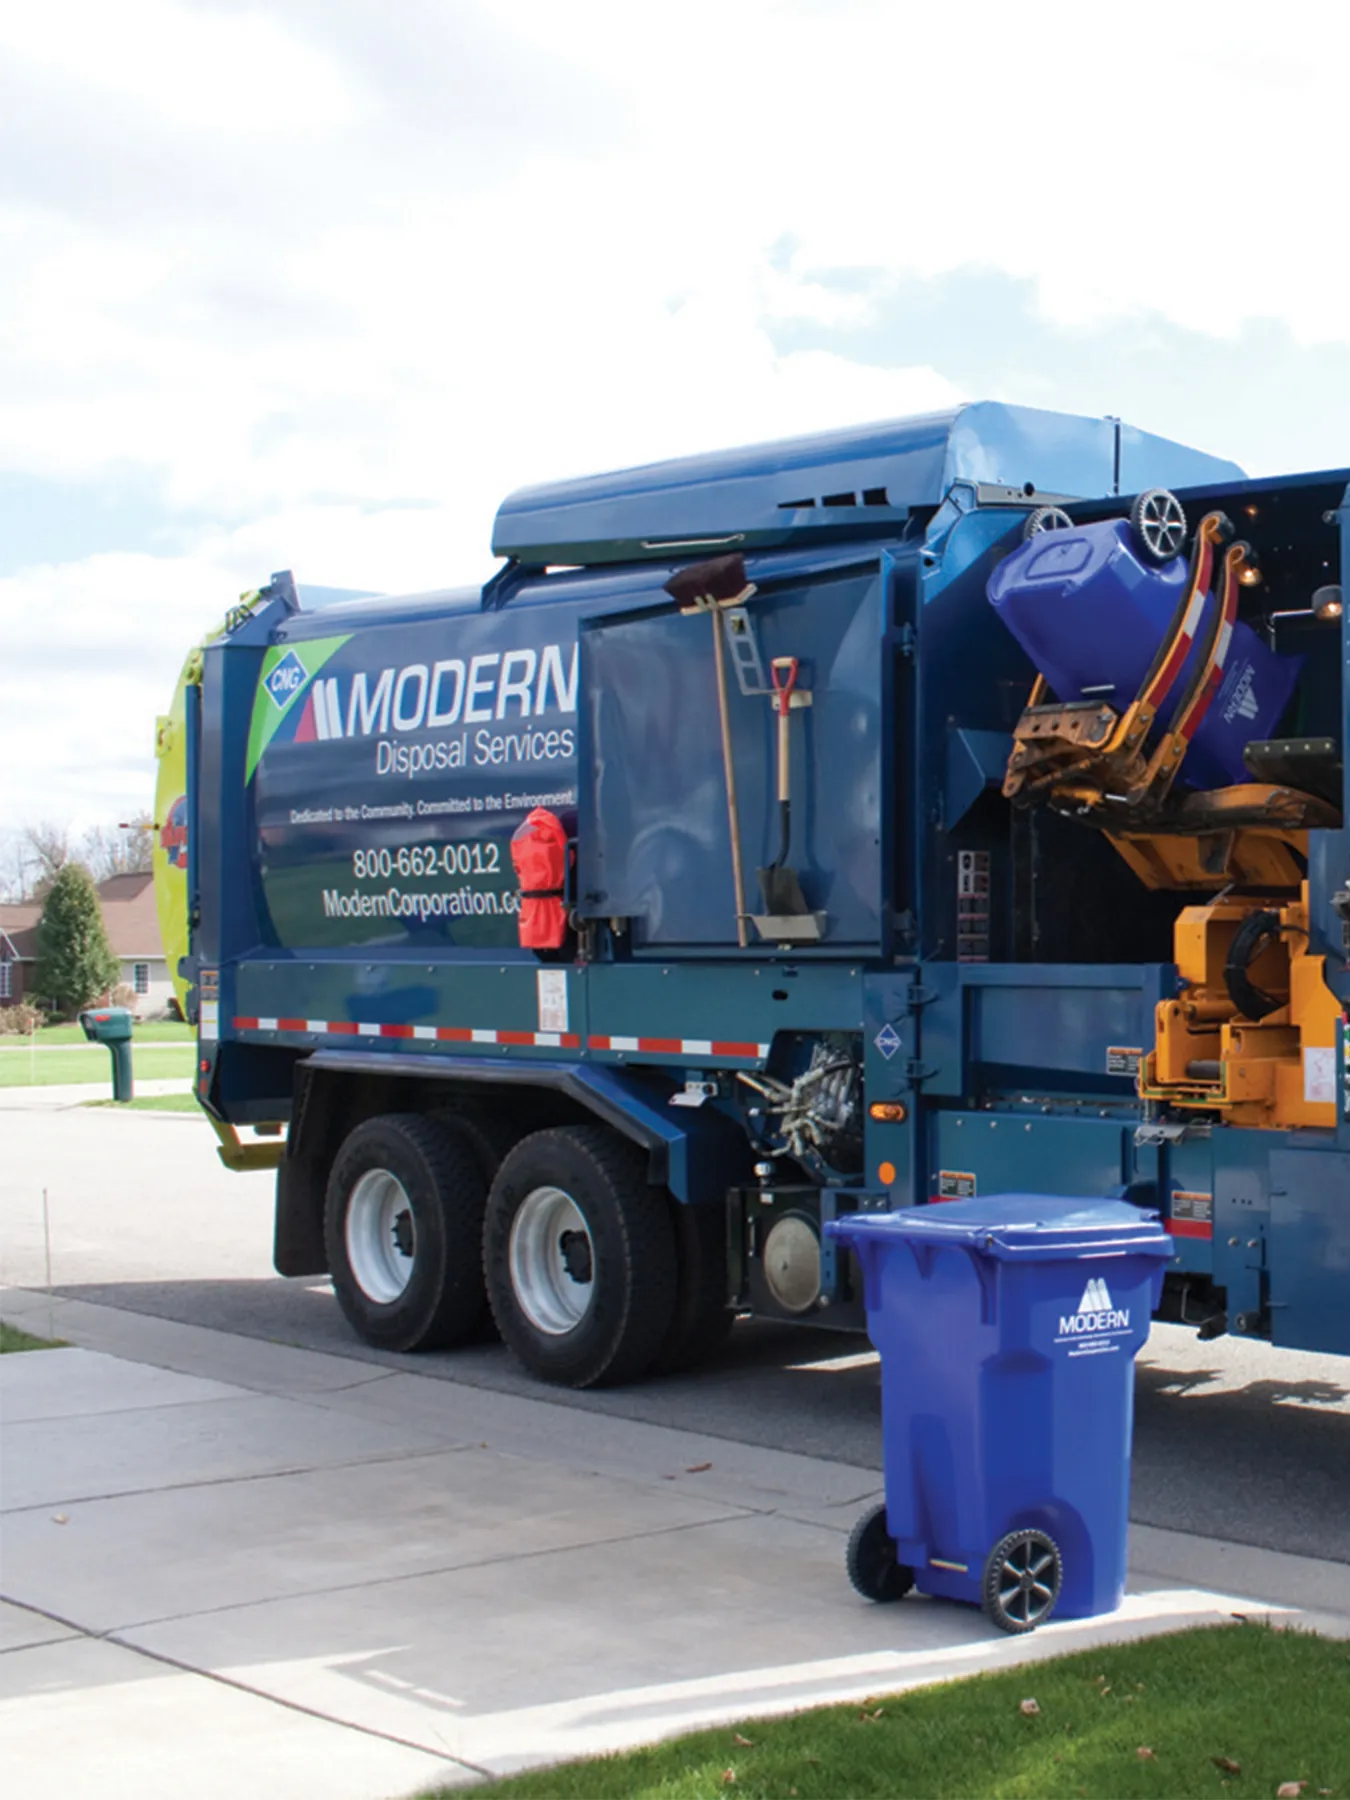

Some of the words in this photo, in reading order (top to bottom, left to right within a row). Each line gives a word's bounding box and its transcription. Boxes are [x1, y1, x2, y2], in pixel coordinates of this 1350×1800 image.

[270, 667, 300, 692] CNG
[346, 641, 579, 737] MODERN
[376, 732, 467, 779] Disposal
[473, 724, 575, 766] Services
[289, 806, 333, 824] Dedicated
[333, 808, 344, 821] to
[344, 805, 359, 820] the
[417, 797, 471, 816] Committed
[472, 797, 485, 811] to
[485, 794, 502, 810] the
[353, 842, 500, 879] 800-662-0012
[322, 885, 522, 922] ModernCorporation.co
[1059, 1308, 1129, 1335] MODERN
